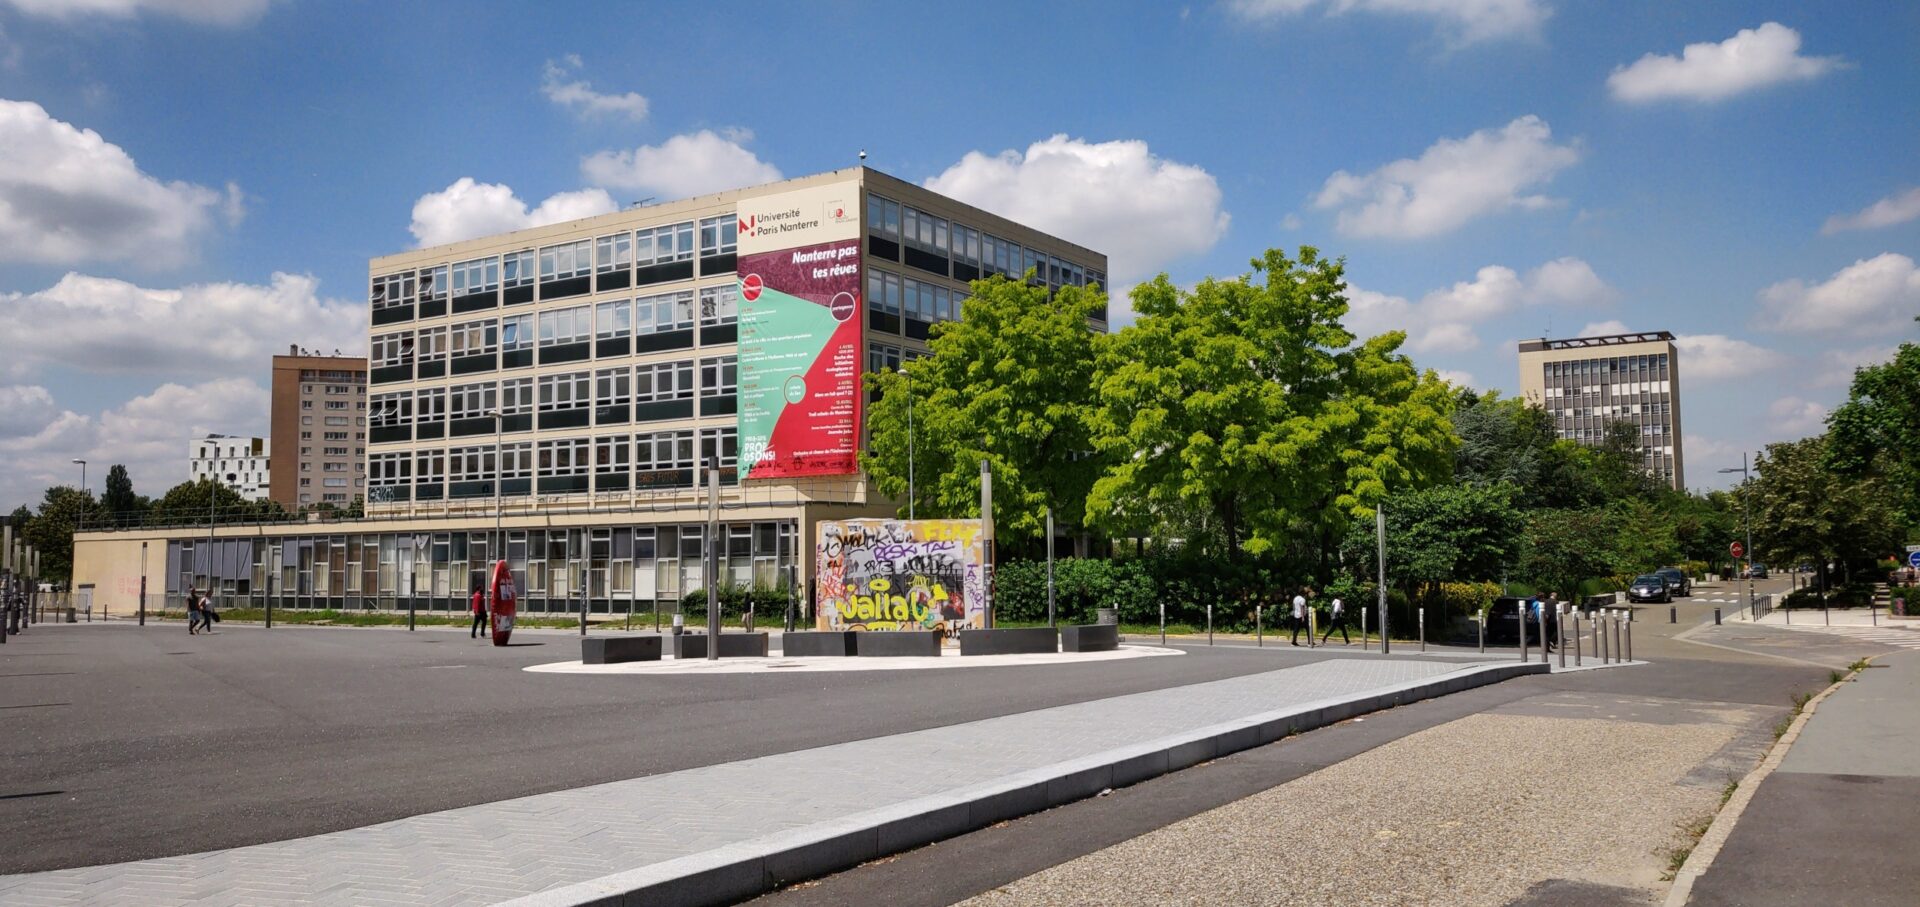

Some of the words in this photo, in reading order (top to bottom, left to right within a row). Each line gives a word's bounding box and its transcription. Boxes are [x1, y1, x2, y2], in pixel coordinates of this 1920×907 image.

[757, 208, 800, 223] Université
[757, 226, 778, 236] Paris
[780, 219, 819, 232] Nanterre
[792, 250, 837, 264] Nanterre
[838, 246, 857, 260] pas
[813, 267, 828, 279] tes
[829, 264, 858, 277] rêves
